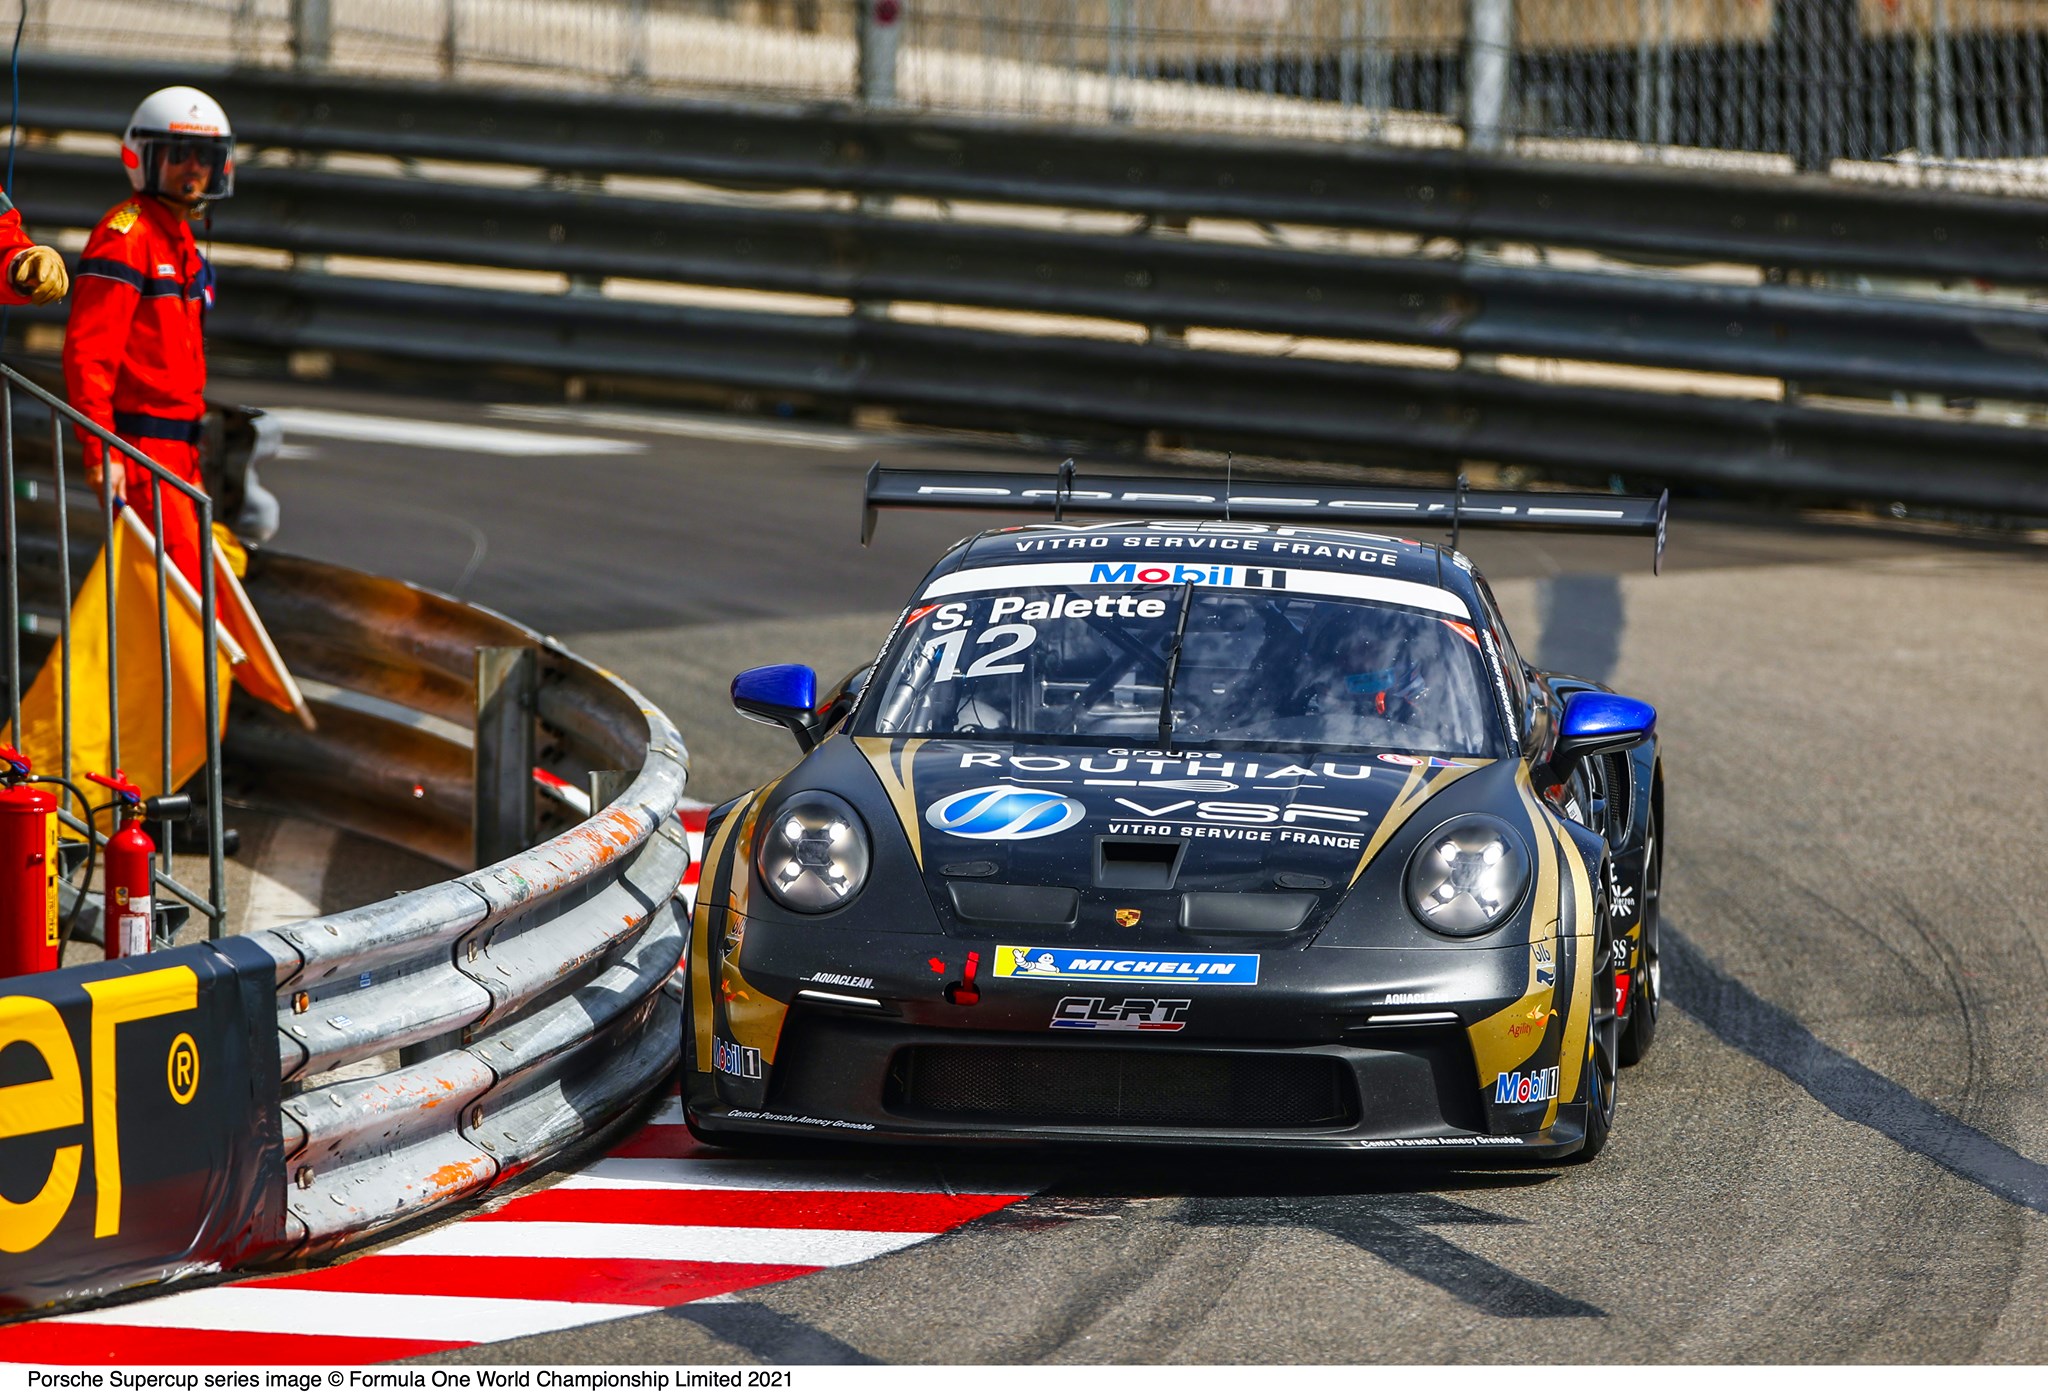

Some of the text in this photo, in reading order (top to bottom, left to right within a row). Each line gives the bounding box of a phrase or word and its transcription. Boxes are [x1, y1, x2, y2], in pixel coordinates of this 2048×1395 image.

[1015, 536, 1398, 567] VITRO SERVICE FRANCE
[1090, 563, 1284, 589] Mobil 1
[932, 594, 1166, 631] S. Palette
[924, 624, 1038, 684] 12
[959, 752, 1372, 780] ROUTHIAU
[1107, 748, 1223, 760] Groupe
[1114, 797, 1370, 823] VSF
[1108, 823, 1361, 850] VITRO SERVICE FRANCE
[1067, 957, 1237, 976] MICHELIN
[811, 972, 873, 989] AQUACLEAN
[1053, 997, 1191, 1023] CLRT
[1508, 1022, 1532, 1038] Agility
[713, 1035, 741, 1077] Mobil
[1495, 1067, 1559, 1104] Mobil 1
[728, 1109, 875, 1131] Centre Porsche Annecy Grenoble
[1361, 1135, 1524, 1148] Centre Porsche Annecy Grenoble
